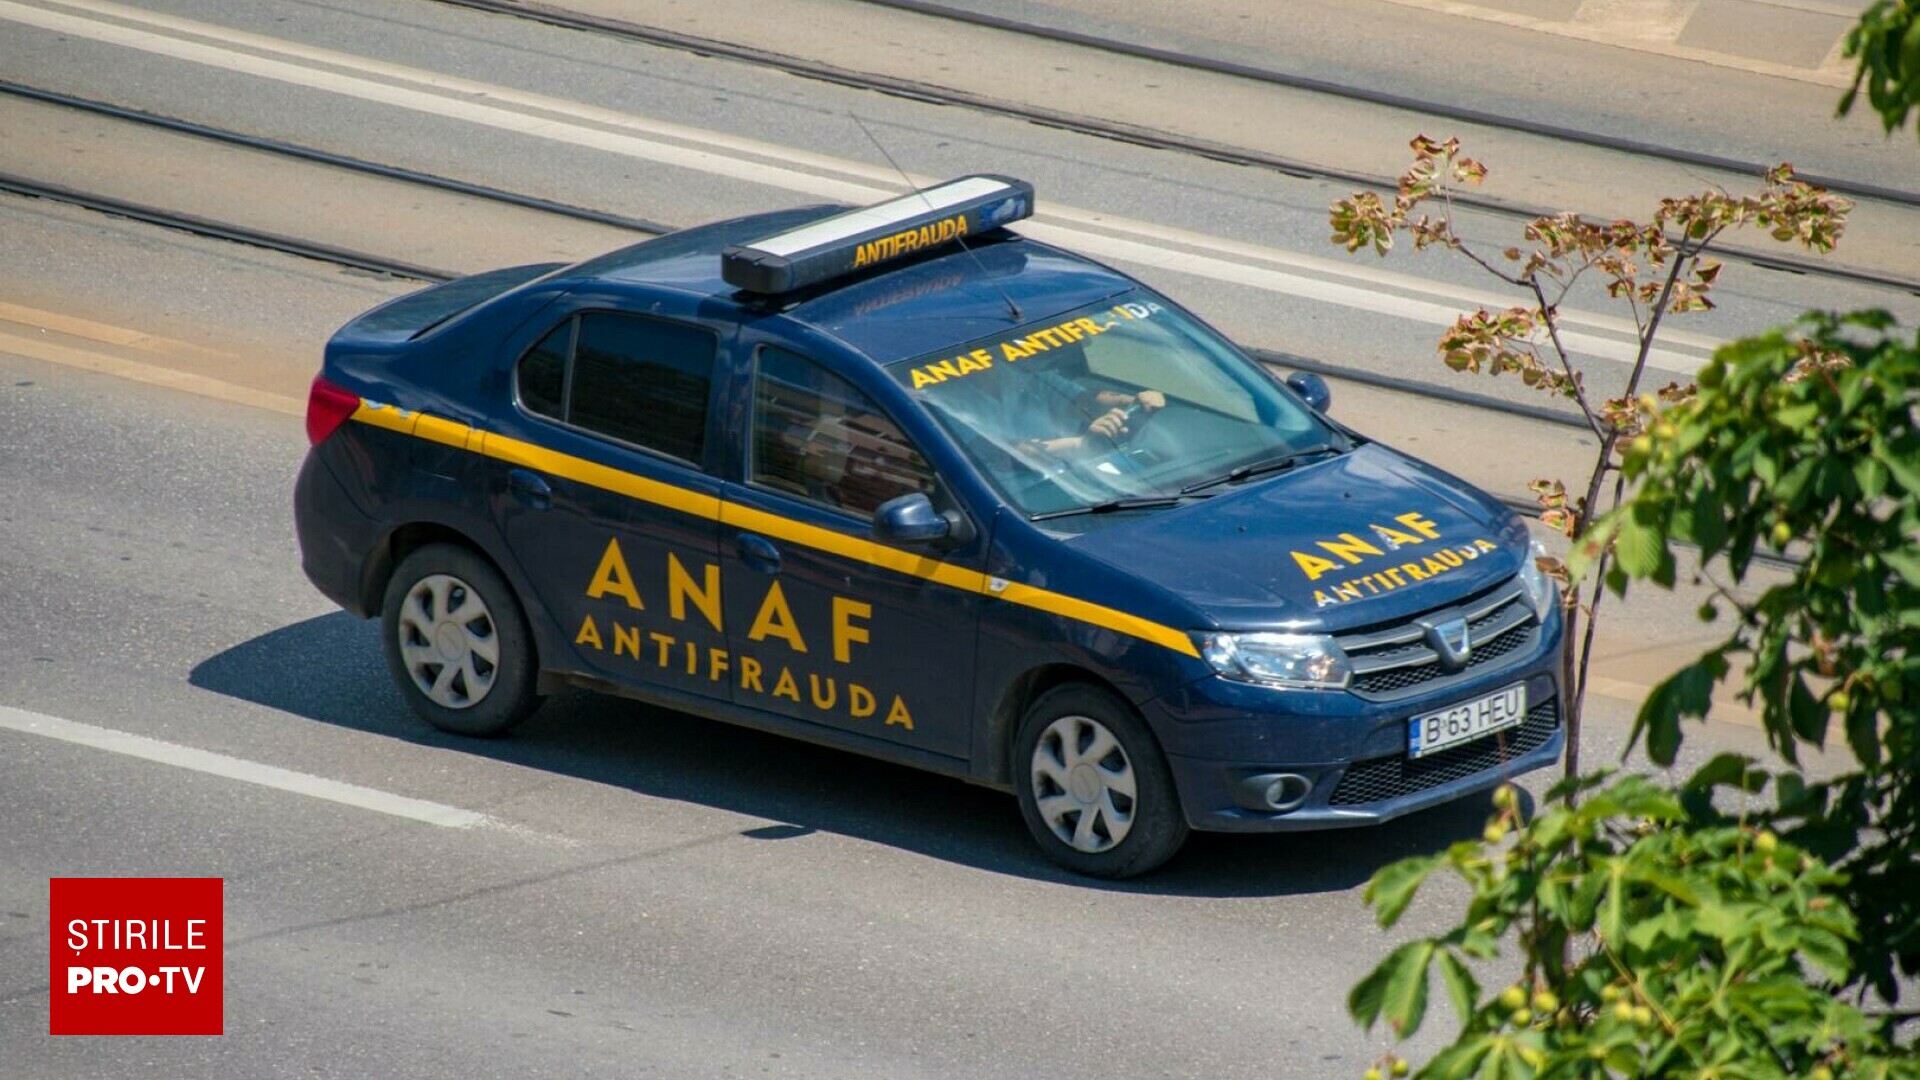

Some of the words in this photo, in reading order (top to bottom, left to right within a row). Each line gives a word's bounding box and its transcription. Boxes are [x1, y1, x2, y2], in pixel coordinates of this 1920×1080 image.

[854, 214, 968, 267] ANTIFRAUDA
[909, 349, 993, 390] ANAF
[1000, 302, 1165, 362] ANTIFRDA
[1290, 512, 1441, 580] ANAF
[1312, 538, 1498, 608] ANTIFRAUDA
[586, 537, 872, 664] ANAF
[575, 614, 914, 730] ANTIFRAUDA
[1426, 717, 1440, 744] B
[1448, 707, 1471, 736] 63
[1478, 689, 1519, 727] HEU
